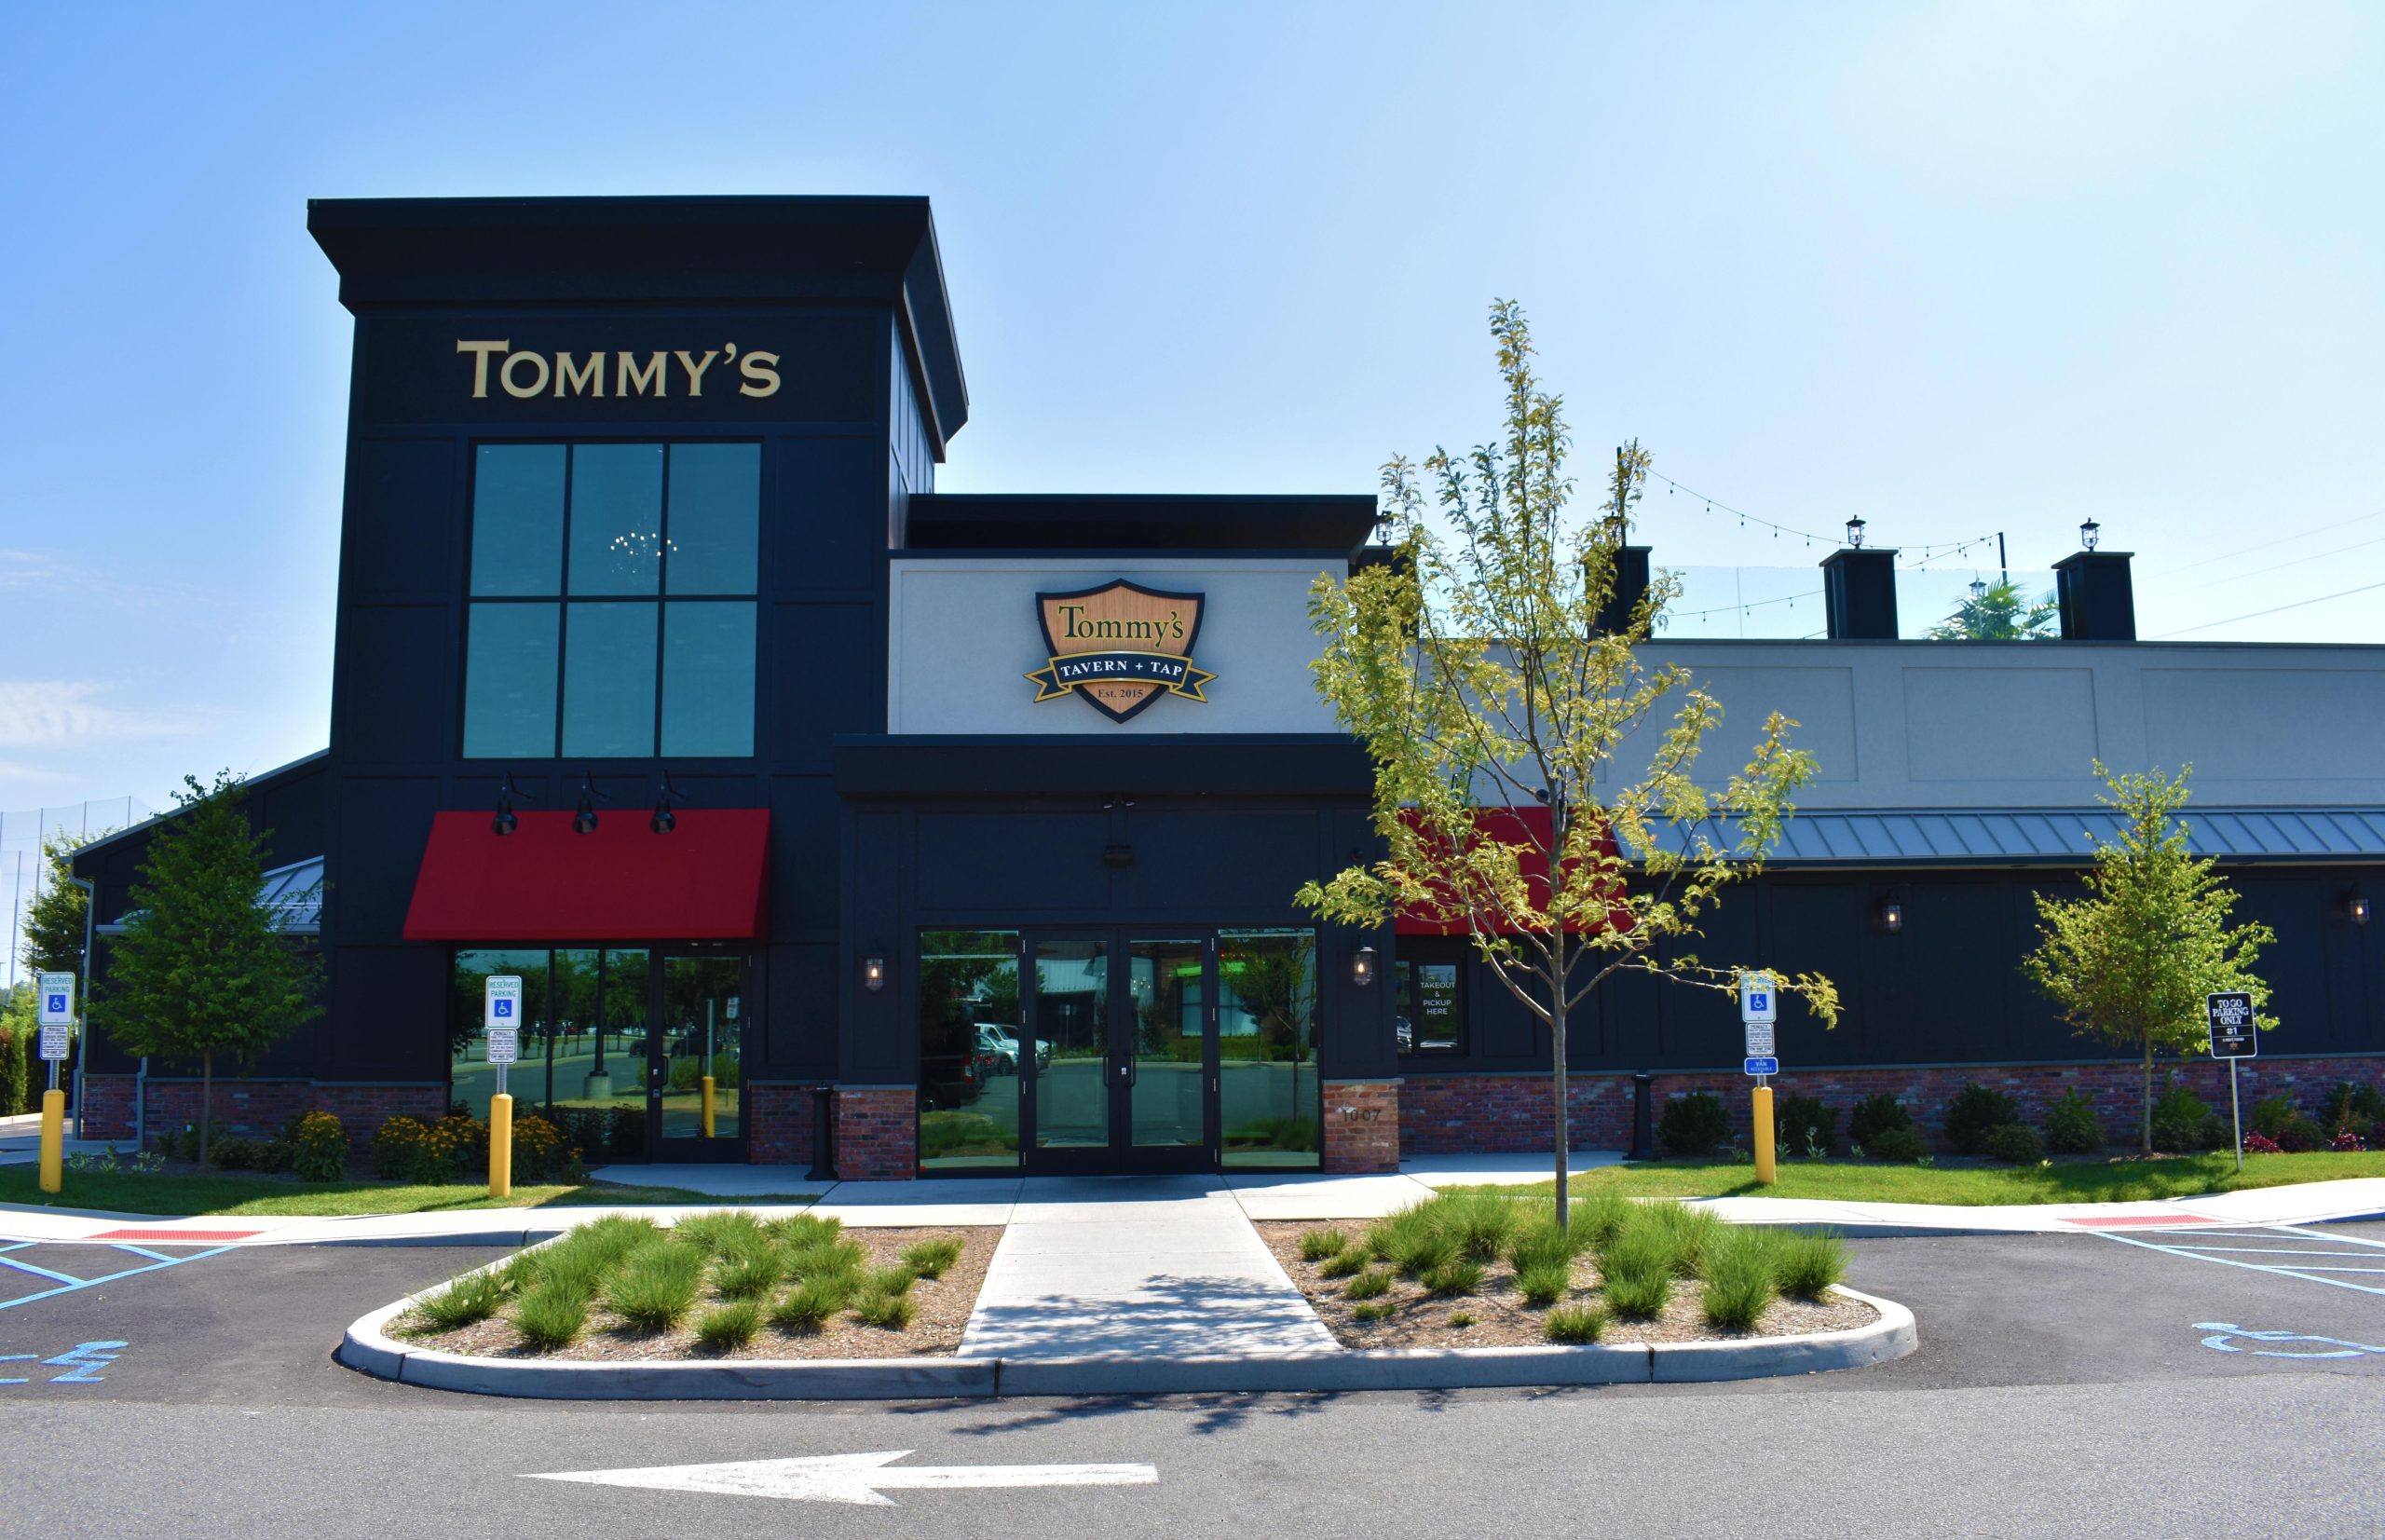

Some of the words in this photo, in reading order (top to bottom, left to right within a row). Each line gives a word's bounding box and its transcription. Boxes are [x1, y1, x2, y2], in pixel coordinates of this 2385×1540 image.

[1058, 605, 1184, 648] Tommy's
[1060, 661, 1128, 677] TAVERN
[1151, 661, 1183, 676] TAP
[1097, 688, 1117, 698] Est.
[1120, 688, 1143, 698] 2015
[2217, 1000, 2229, 1008] TO
[2230, 999, 2242, 1008] GO
[2212, 1007, 2249, 1017] PARKING
[2220, 1015, 2242, 1025] ONLY
[2226, 1027, 2238, 1035] #1
[1342, 1109, 1380, 1123] 1007
